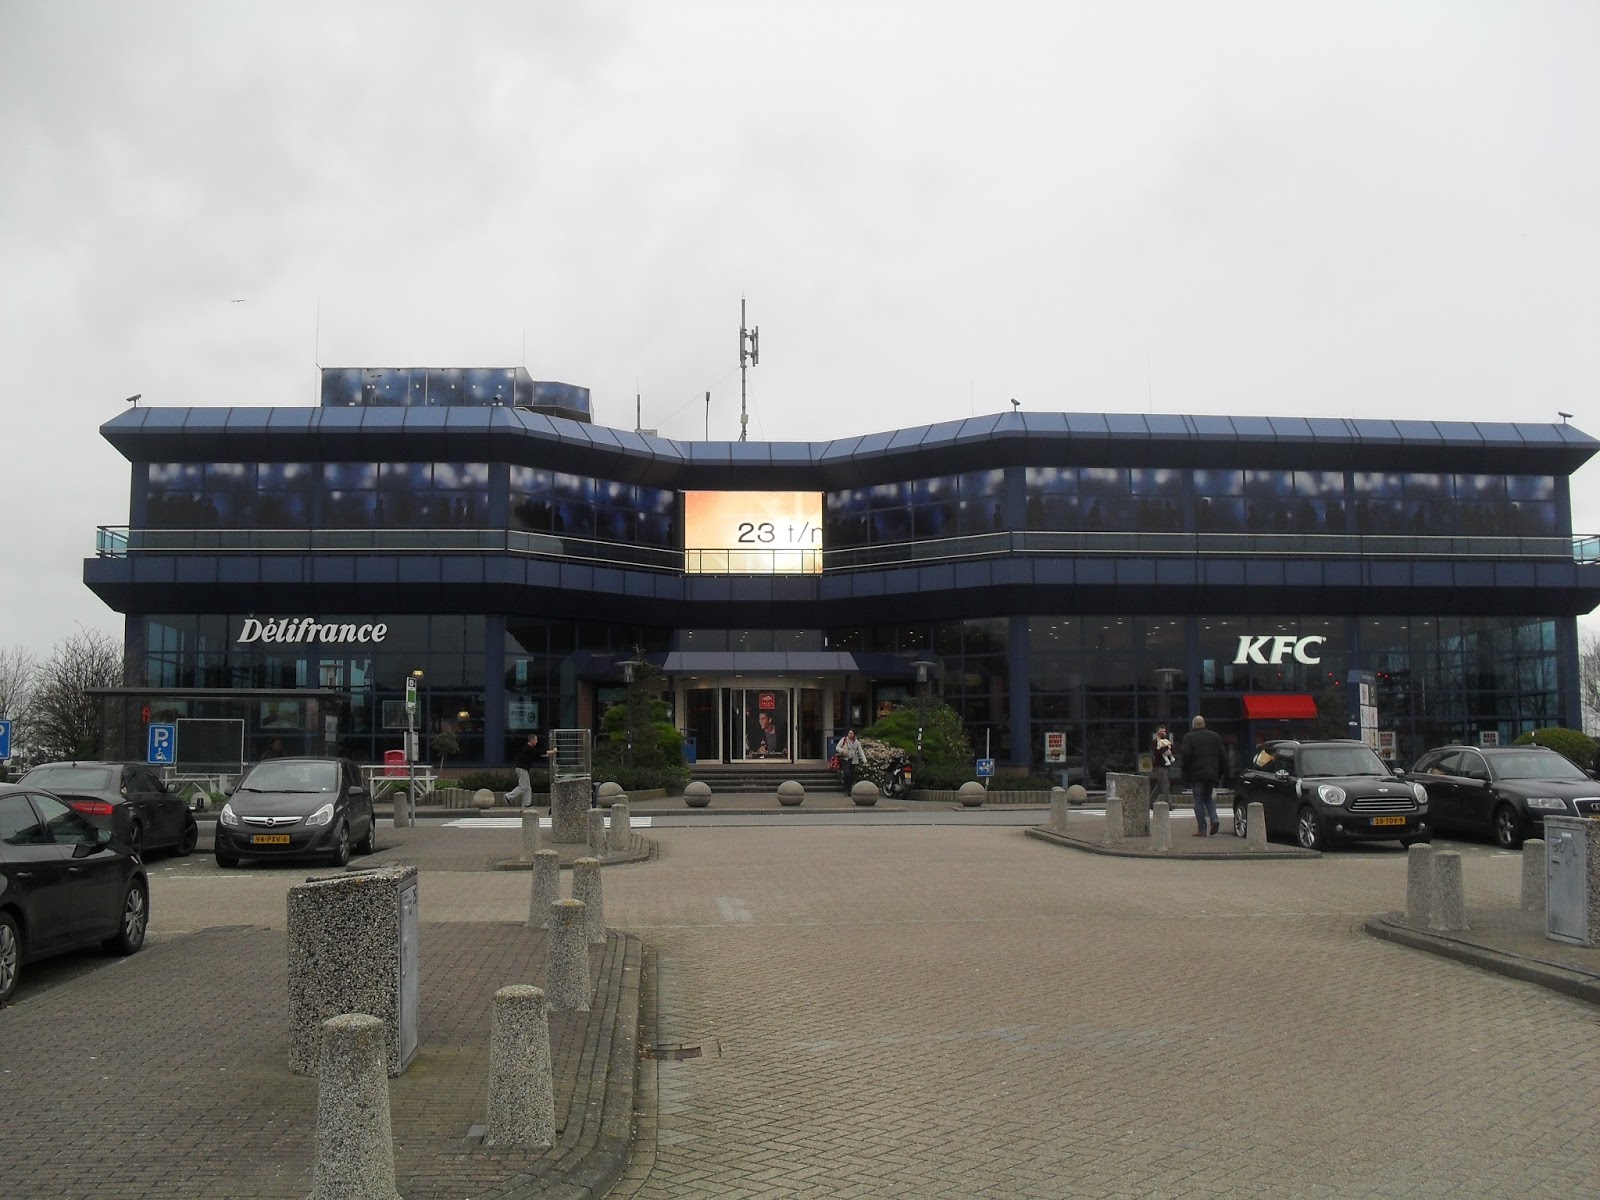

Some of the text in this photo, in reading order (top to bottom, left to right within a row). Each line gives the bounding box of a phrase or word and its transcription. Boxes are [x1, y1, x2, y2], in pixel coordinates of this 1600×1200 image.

[737, 522, 776, 543] 23
[237, 617, 388, 643] Délifrance
[1232, 635, 1324, 665] KFC
[154, 728, 169, 747] P
